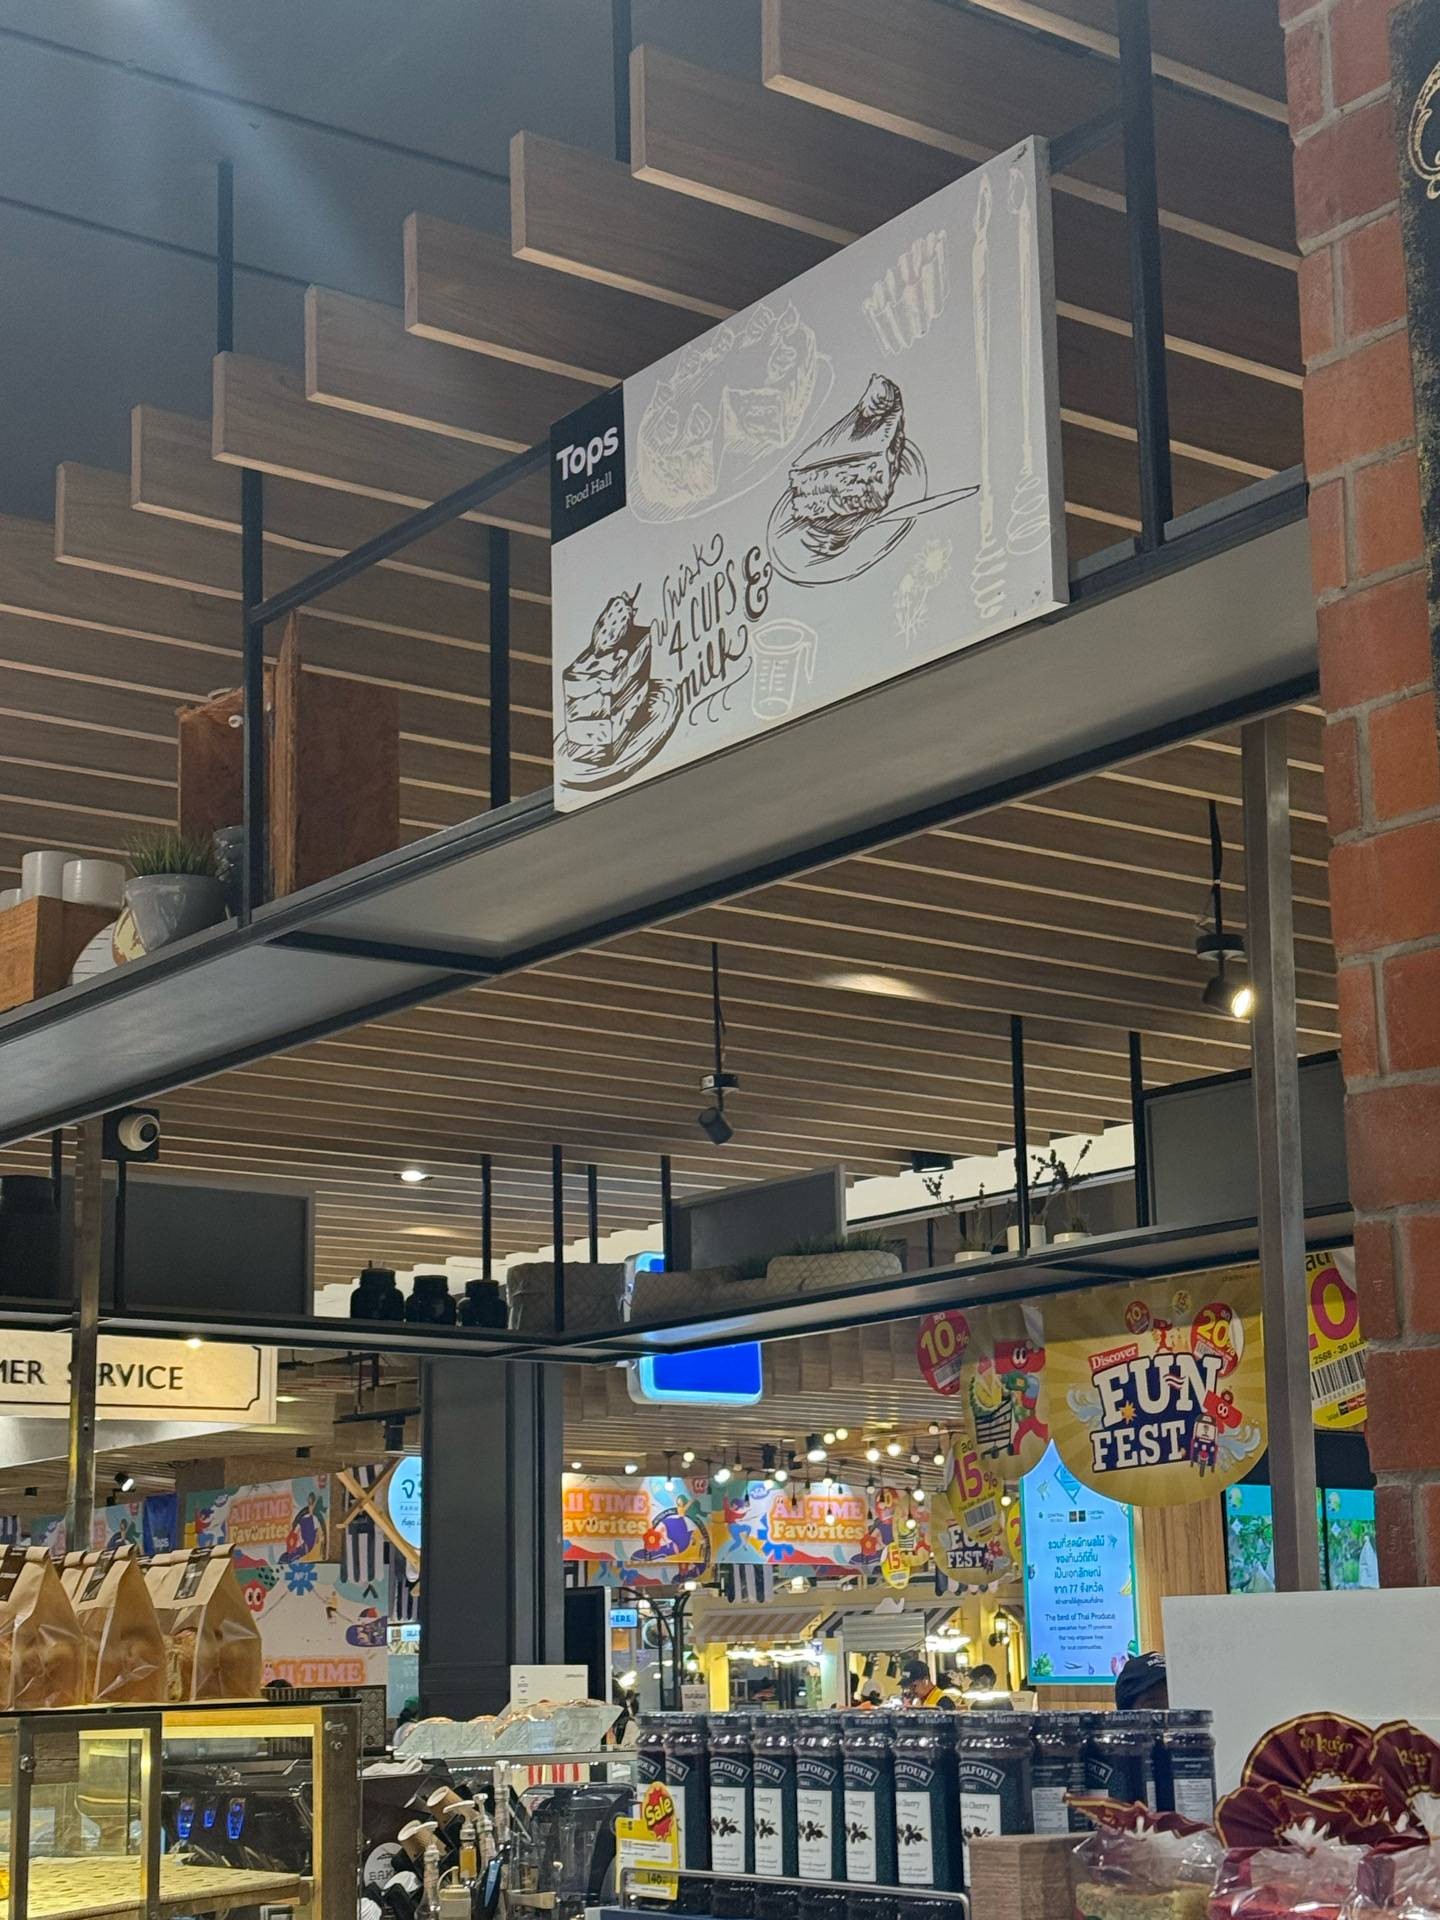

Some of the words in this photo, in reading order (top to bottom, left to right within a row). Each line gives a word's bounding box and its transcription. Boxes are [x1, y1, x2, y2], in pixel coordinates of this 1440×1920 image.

[556, 427, 619, 480] Tops
[565, 484, 590, 508] Food
[590, 471, 612, 494] Hall
[668, 620, 689, 672] 4
[691, 559, 737, 642] CUPS
[1091, 1346, 1137, 1369] Discover
[1093, 1354, 1222, 1427] FUN
[1092, 1420, 1185, 1471] FEST
[590, 1494, 646, 1512] TIME
[564, 1516, 647, 1534] avorites
[773, 1521, 865, 1540] Favorites
[947, 1552, 983, 1568] FEST
[1045, 1613, 1056, 1621] The
[1078, 1612, 1090, 1620] Thai
[303, 1662, 361, 1683] TIME
[645, 1796, 673, 1826] Sale
